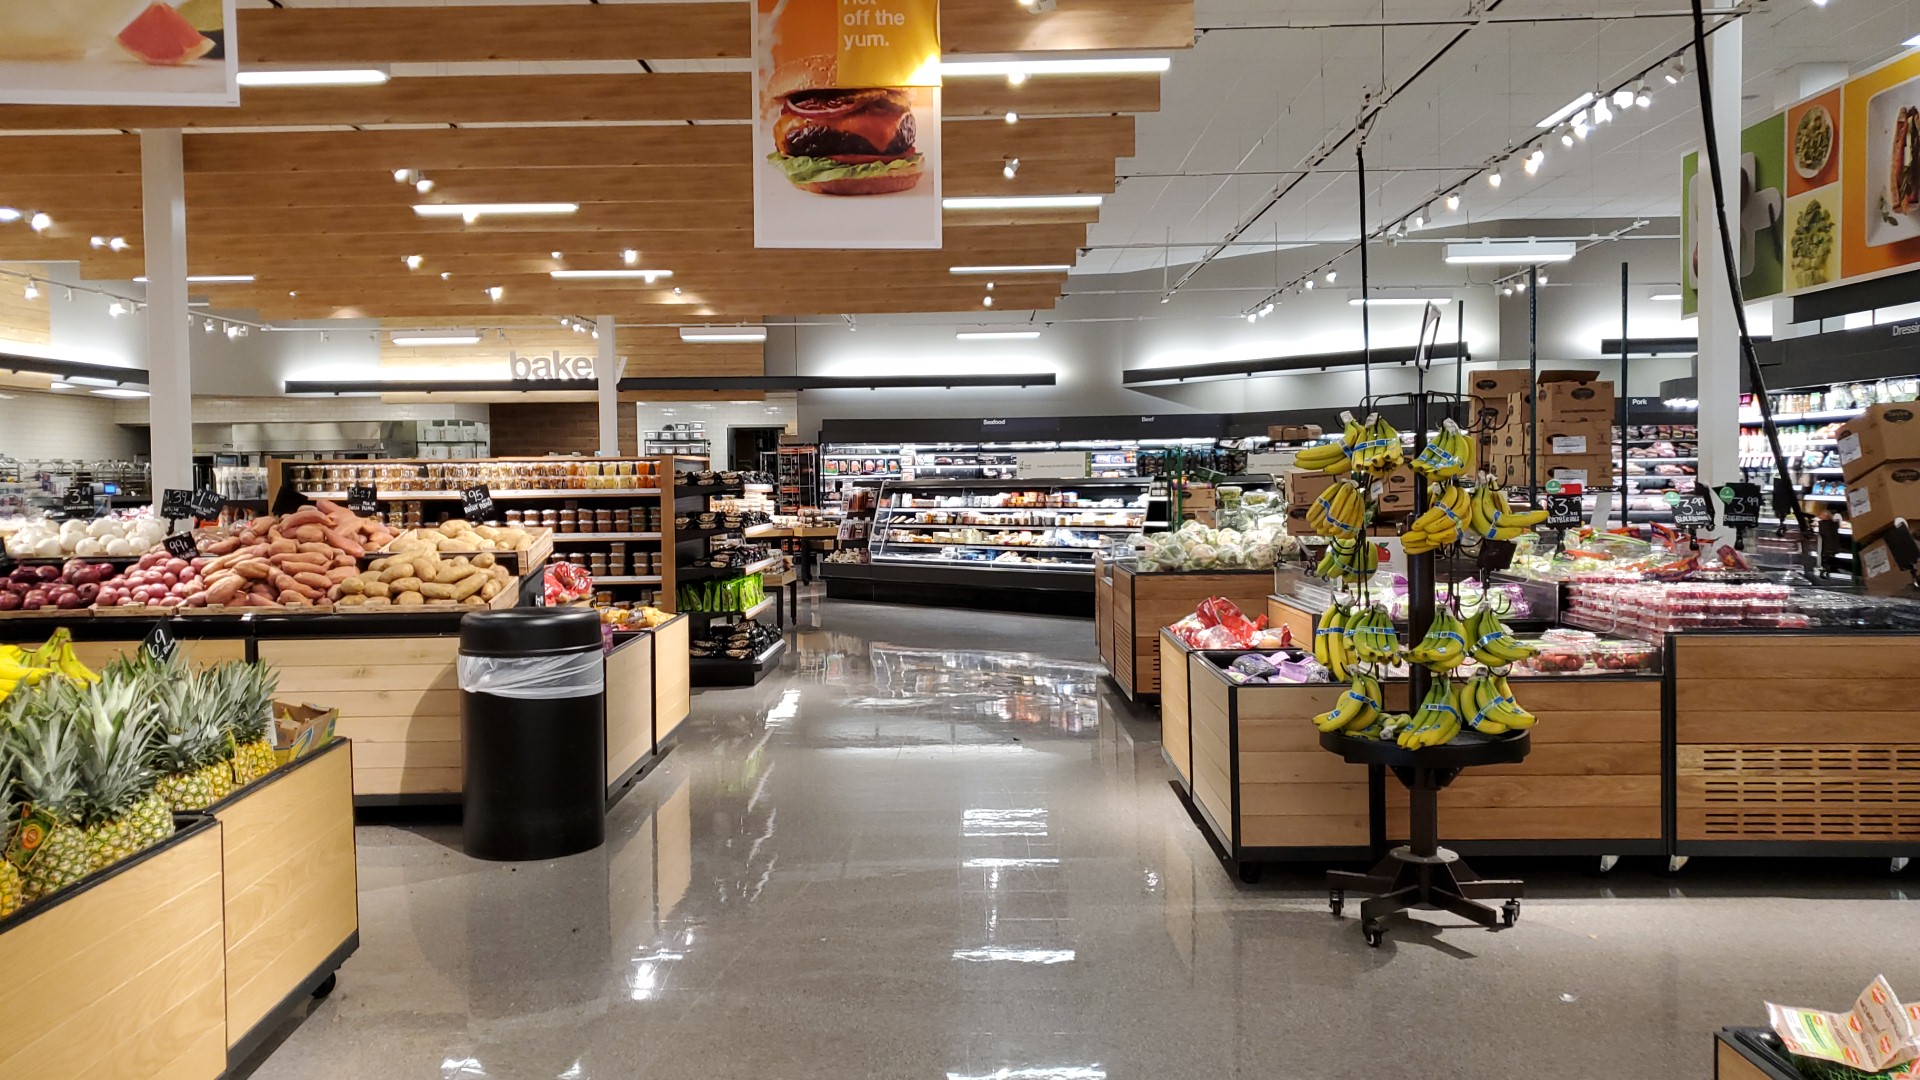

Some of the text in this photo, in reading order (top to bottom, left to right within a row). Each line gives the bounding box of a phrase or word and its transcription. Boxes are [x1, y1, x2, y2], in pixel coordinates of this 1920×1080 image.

[843, 9, 905, 26] off the
[843, 34, 890, 51] yum.
[1632, 398, 1648, 406] Pork
[983, 418, 1006, 426] Seafood
